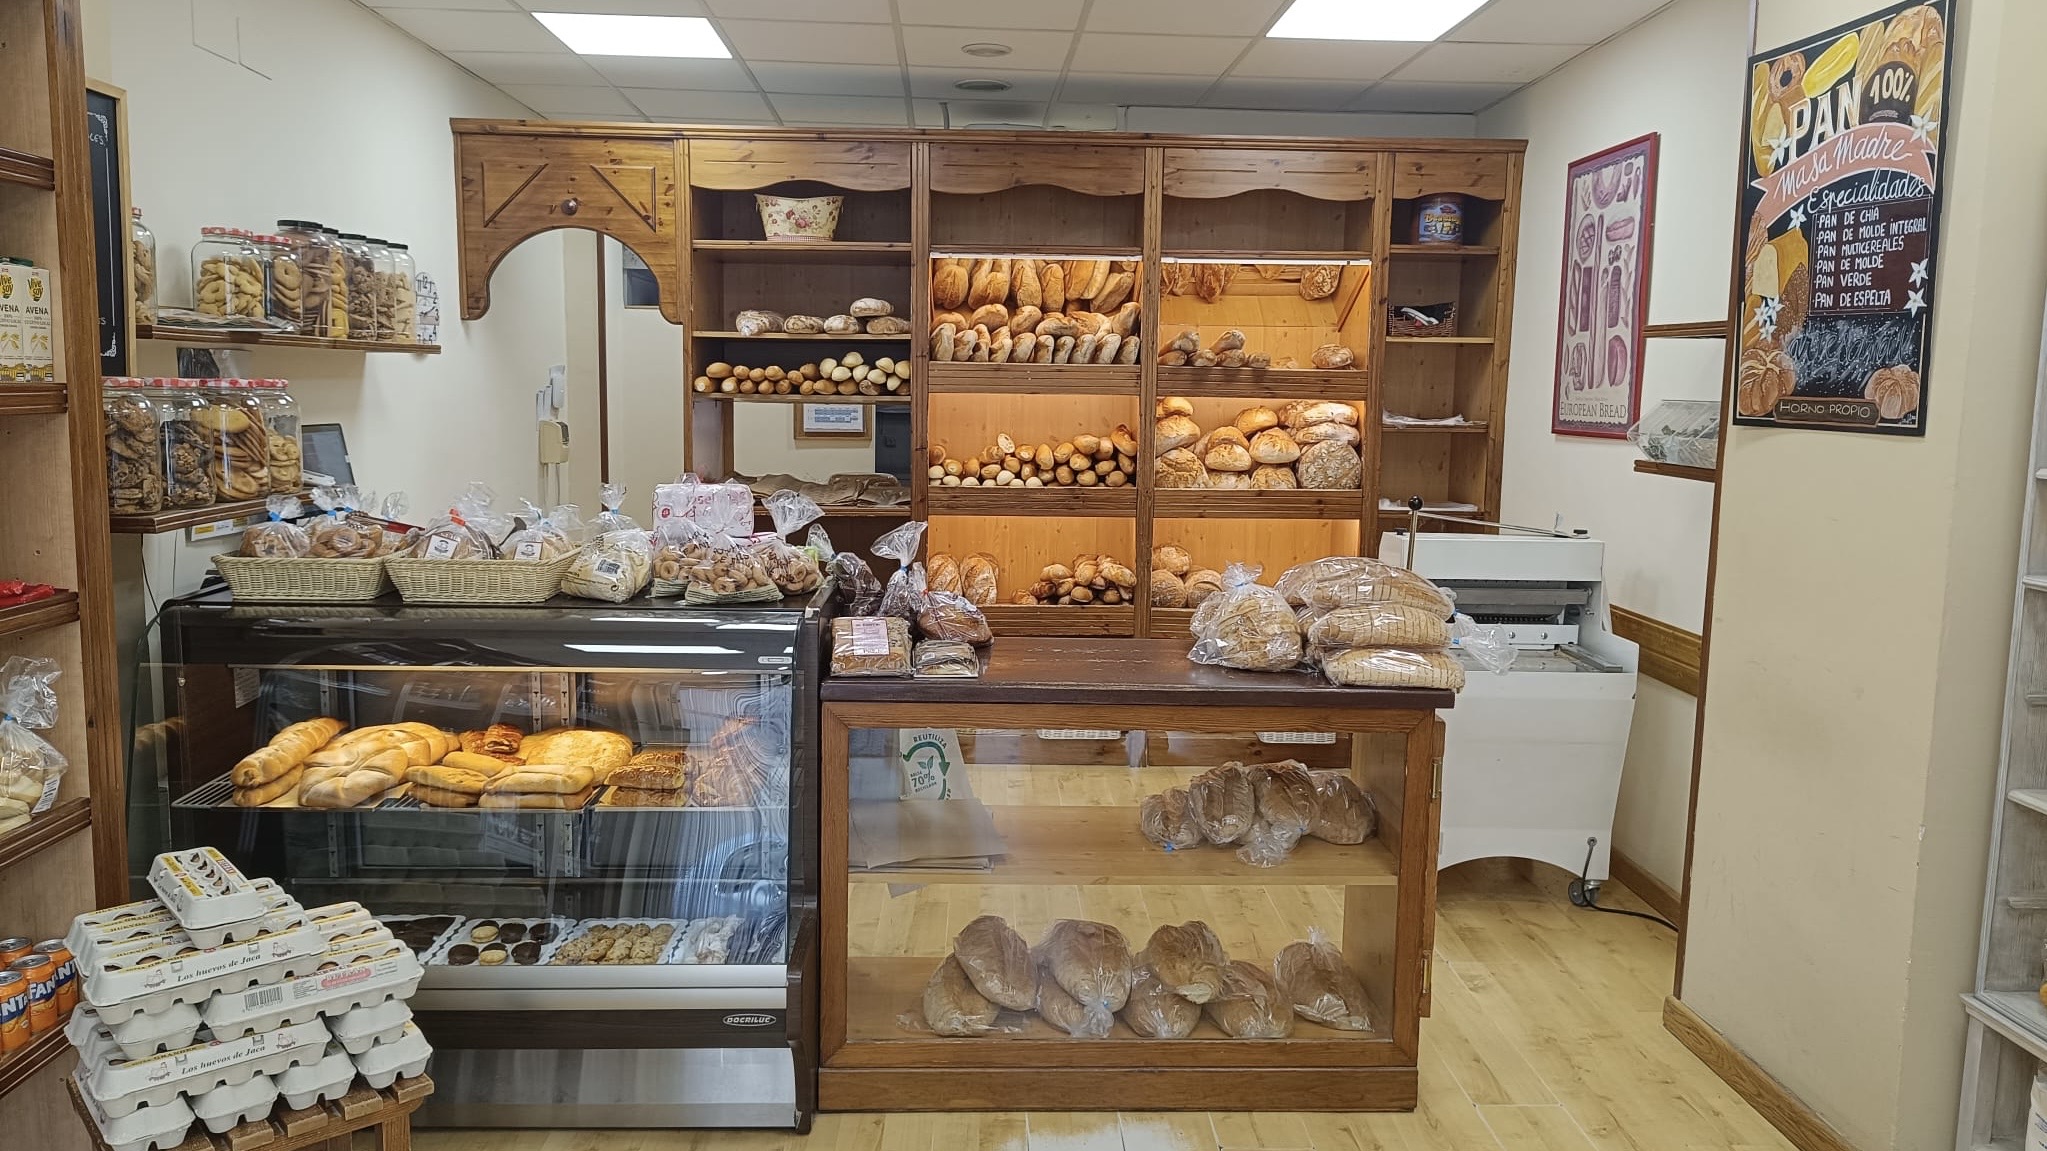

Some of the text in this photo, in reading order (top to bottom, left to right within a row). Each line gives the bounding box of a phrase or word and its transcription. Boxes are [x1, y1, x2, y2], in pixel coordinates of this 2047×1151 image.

[1870, 67, 1914, 104] 100%
[1788, 77, 1864, 164] PAN
[1774, 126, 1912, 201] Masa Madre
[1807, 170, 1925, 213] Especialidades
[1818, 214, 1837, 228] PAN
[1844, 213, 1855, 225] DE
[1818, 231, 1837, 244] PAN
[1843, 228, 1854, 240] DE
[1859, 224, 1886, 238] MOLDE
[1817, 236, 1904, 259] PAN MULTICEREALES
[1817, 254, 1884, 273] PAN DE MOLDE
[1816, 272, 1872, 288] PAN VERDE
[1815, 289, 1891, 308] PAN DE ESPELTA
[0, 304, 19, 313] VENA
[25, 306, 49, 316] AVENA
[1560, 401, 1627, 418] EUROPEAN BREAD
[1780, 403, 1871, 418] HORNO PROPIO
[177, 953, 261, 982] Los huevos de Jaca
[182, 1045, 265, 1075] Los huevos de Jaca
